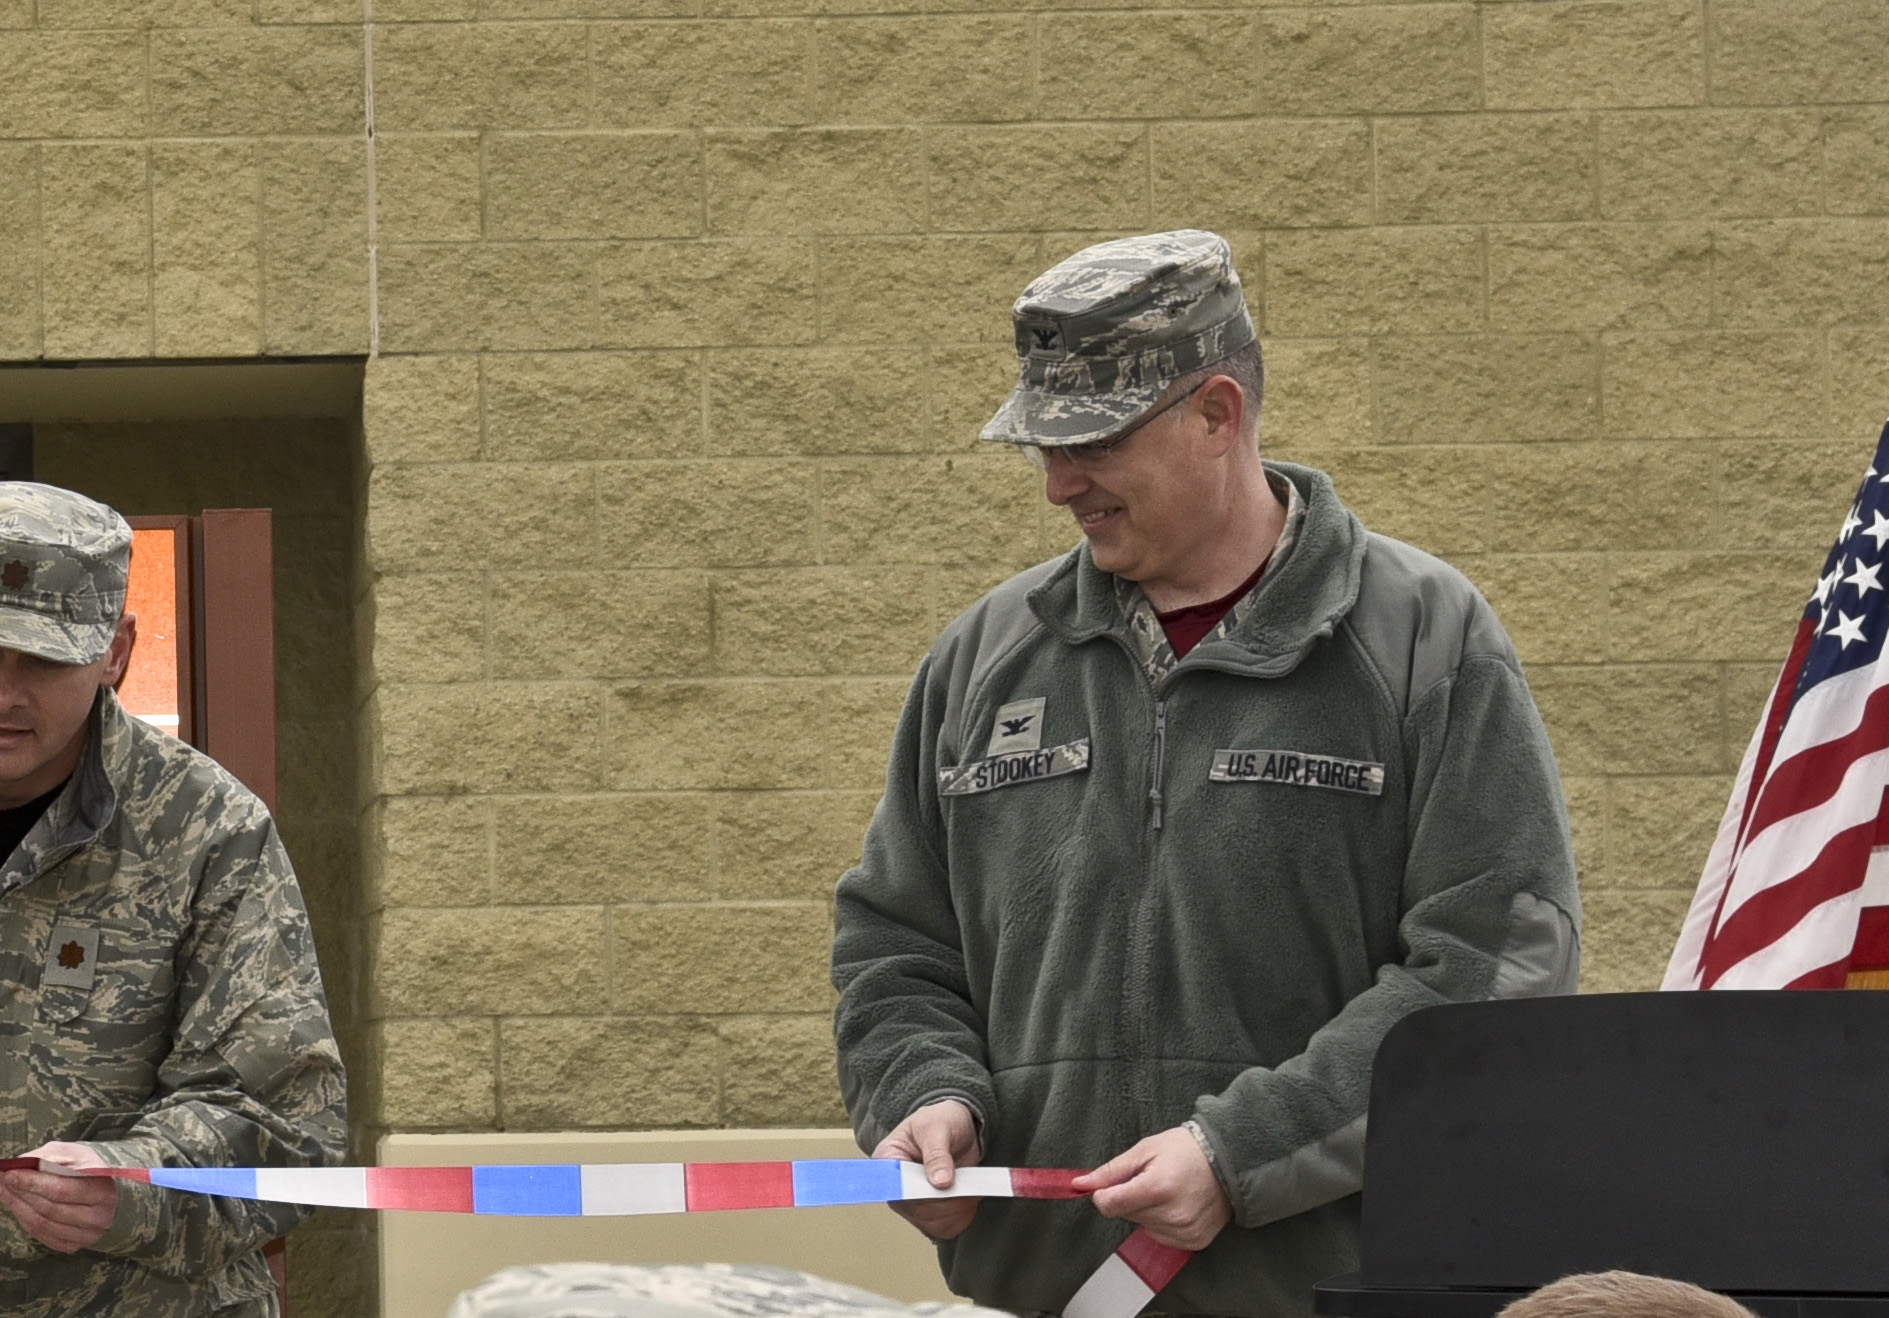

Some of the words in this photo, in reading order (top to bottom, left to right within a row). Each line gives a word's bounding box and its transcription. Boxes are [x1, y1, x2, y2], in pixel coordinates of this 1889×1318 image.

[975, 751, 1055, 788] STOOKEY
[1227, 753, 1258, 777] U.S.
[1262, 753, 1300, 781] AIR
[1304, 759, 1372, 790] FORCE
